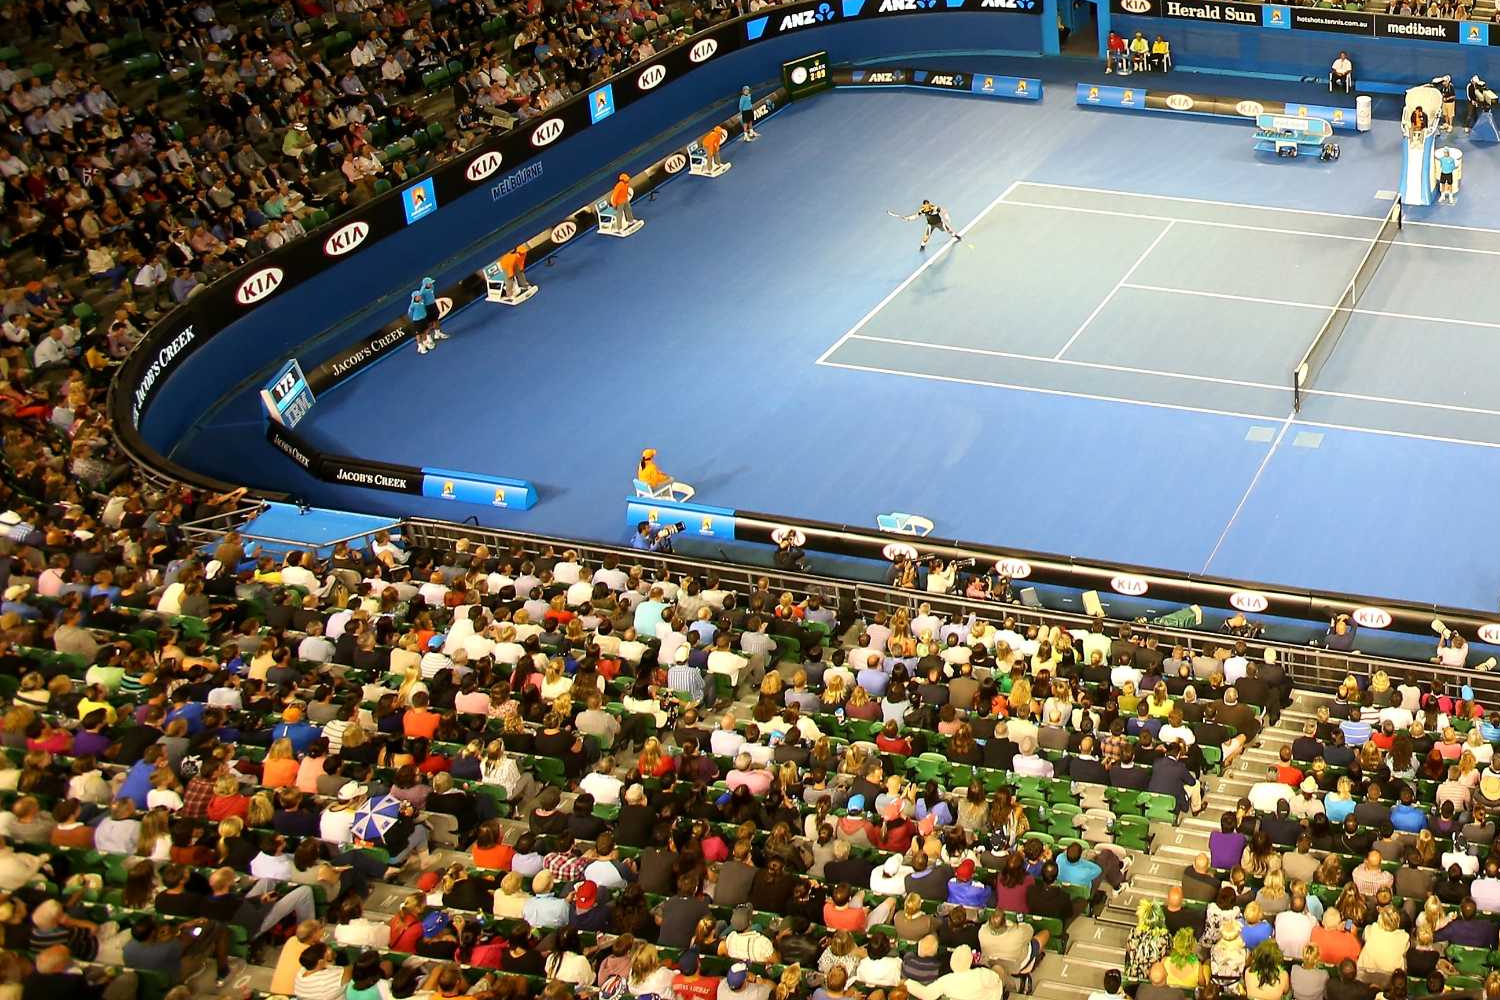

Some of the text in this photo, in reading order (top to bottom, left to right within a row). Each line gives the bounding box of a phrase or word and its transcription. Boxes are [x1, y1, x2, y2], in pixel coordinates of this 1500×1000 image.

[1167, 1, 1257, 22] Herald Sun
[780, 10, 816, 31] ANZ
[1297, 16, 1368, 28] hotshots.tennis.com.au
[1387, 23, 1446, 37] medibank
[694, 41, 716, 58] KIA
[643, 67, 664, 87] KIA
[869, 73, 893, 82] ANZ
[931, 75, 953, 86] ANZ
[1171, 96, 1190, 106] KIA
[1240, 101, 1260, 111] KIA
[753, 104, 769, 121] ANZ
[537, 121, 562, 145] KIA
[471, 154, 498, 179] KIA
[666, 157, 685, 172] KIA
[491, 161, 544, 201] MELBOURNE
[332, 225, 367, 253] KIA
[556, 224, 575, 241] KIA
[243, 273, 279, 301] KIA
[159, 325, 195, 367] CREEK
[333, 327, 405, 376] JACOB'S CREEK
[275, 373, 295, 399] 173
[287, 392, 313, 428] IBM
[337, 469, 407, 489] JACOB'S CREEK
[1001, 563, 1024, 575] KIA
[1117, 581, 1142, 592] KIA
[1236, 597, 1261, 608] KIA
[1359, 613, 1384, 624] KIA
[1148, 864, 1159, 874] H
